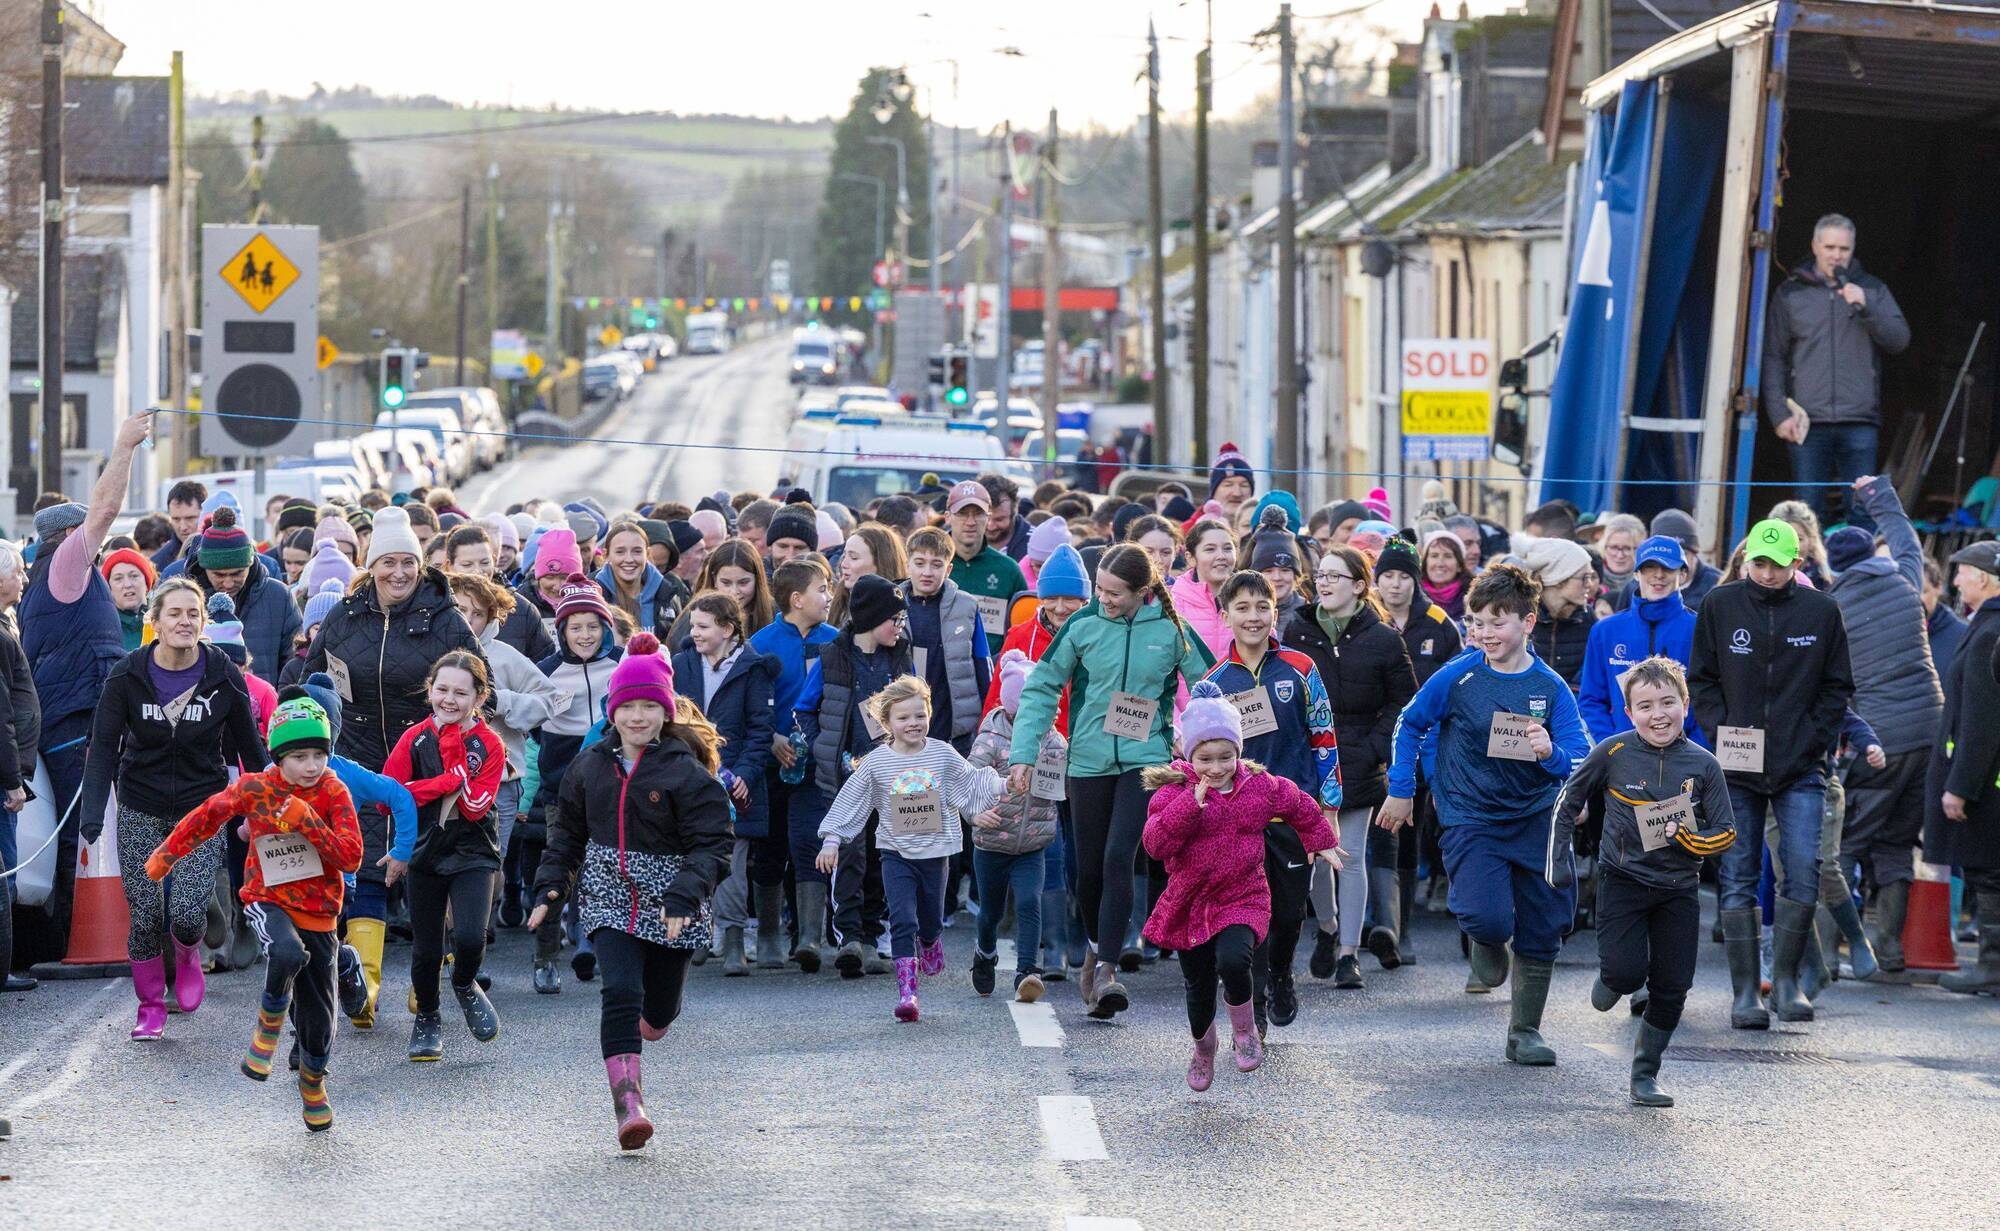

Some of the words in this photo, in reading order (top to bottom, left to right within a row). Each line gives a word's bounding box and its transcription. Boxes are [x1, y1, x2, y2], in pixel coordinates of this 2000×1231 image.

[1407, 352, 1489, 377] SOLD
[1115, 705, 1149, 720] WALKER
[1240, 702, 1264, 715] LKER
[1115, 717, 1142, 731] 408
[1501, 739, 1519, 749] 59
[1723, 740, 1757, 750] WALKER
[1037, 769, 1061, 780] WALKER
[898, 804, 935, 814] WALKER
[904, 816, 928, 828] 407
[264, 844, 308, 859] WALKER
[280, 855, 305, 871] 535
